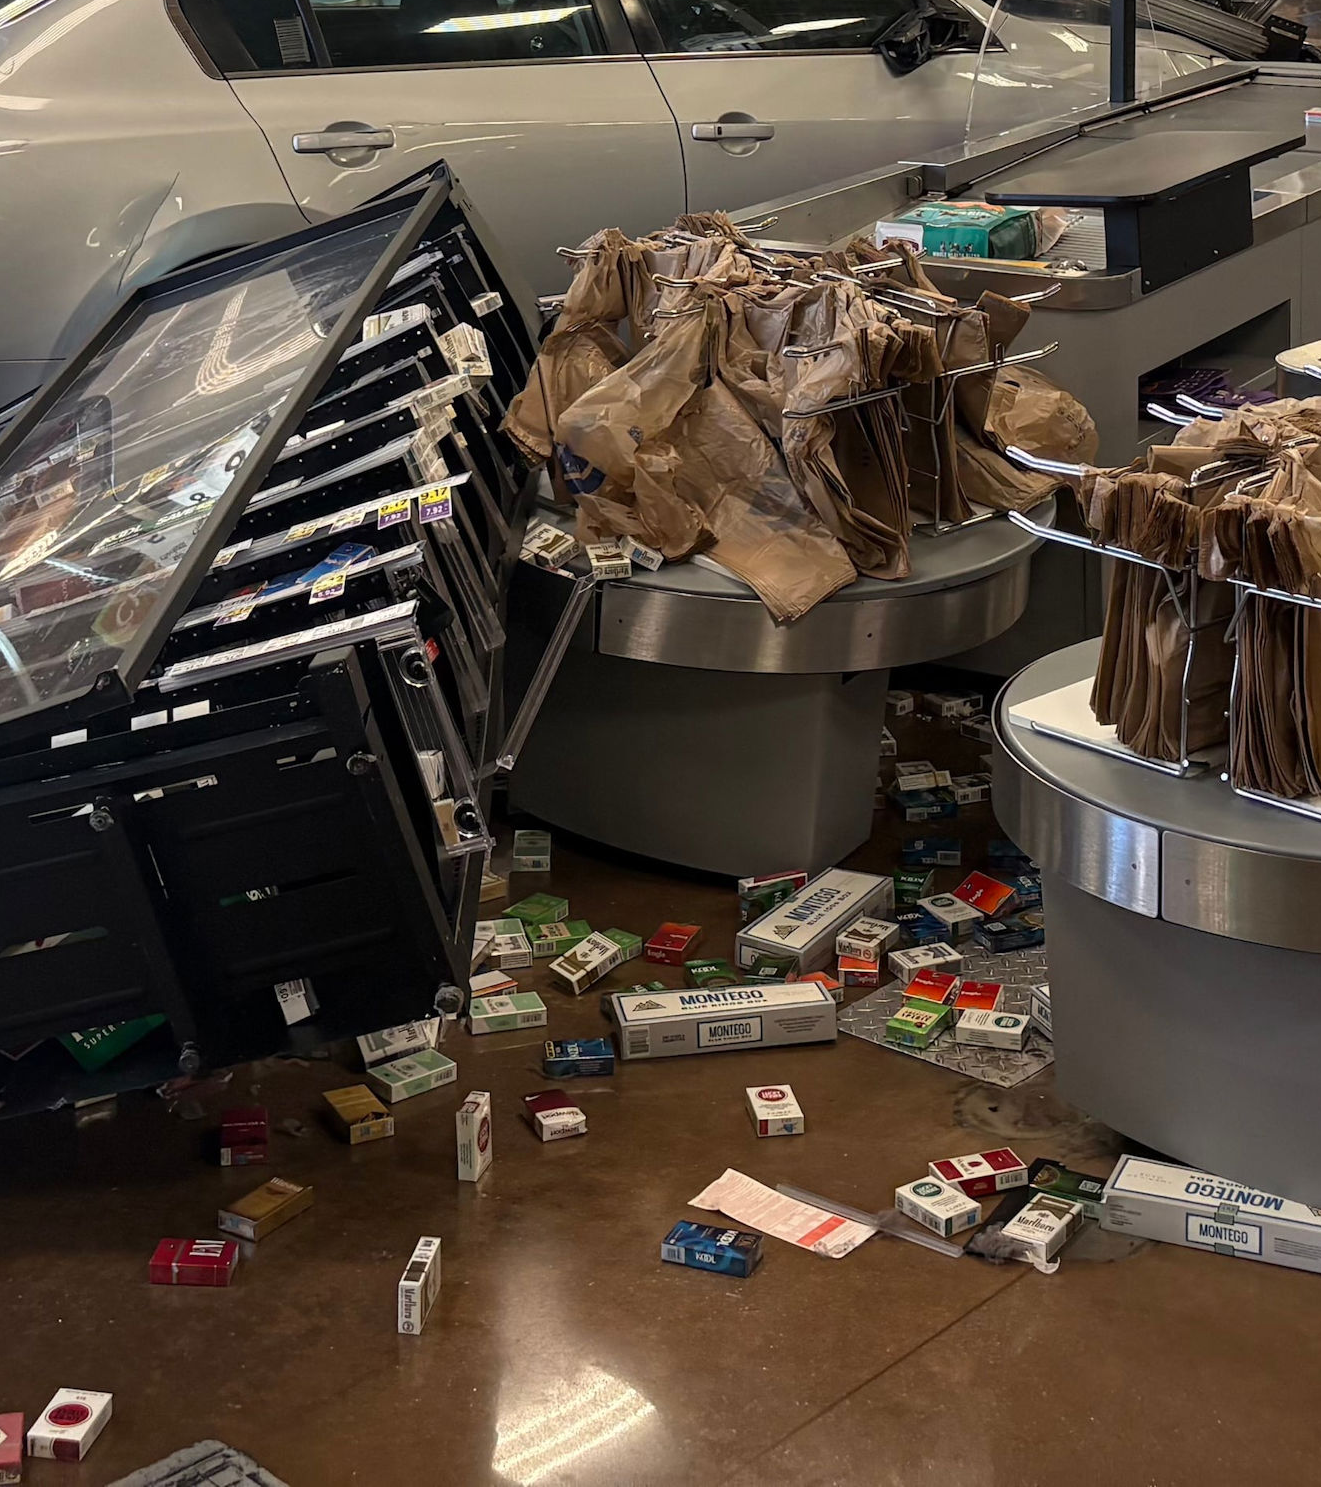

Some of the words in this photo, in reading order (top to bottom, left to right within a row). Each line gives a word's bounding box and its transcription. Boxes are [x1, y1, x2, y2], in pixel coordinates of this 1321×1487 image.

[785, 886, 841, 923] MONTEGO
[679, 989, 764, 1006] MONTEGO
[83, 1023, 116, 1050] SUPER
[709, 1022, 752, 1038] MONTEGO
[1184, 1180, 1285, 1211] MONTEGO
[1016, 1215, 1055, 1233] Marlboro
[1198, 1224, 1249, 1244] MONTEGO
[403, 1286, 416, 1320] Marlboro
